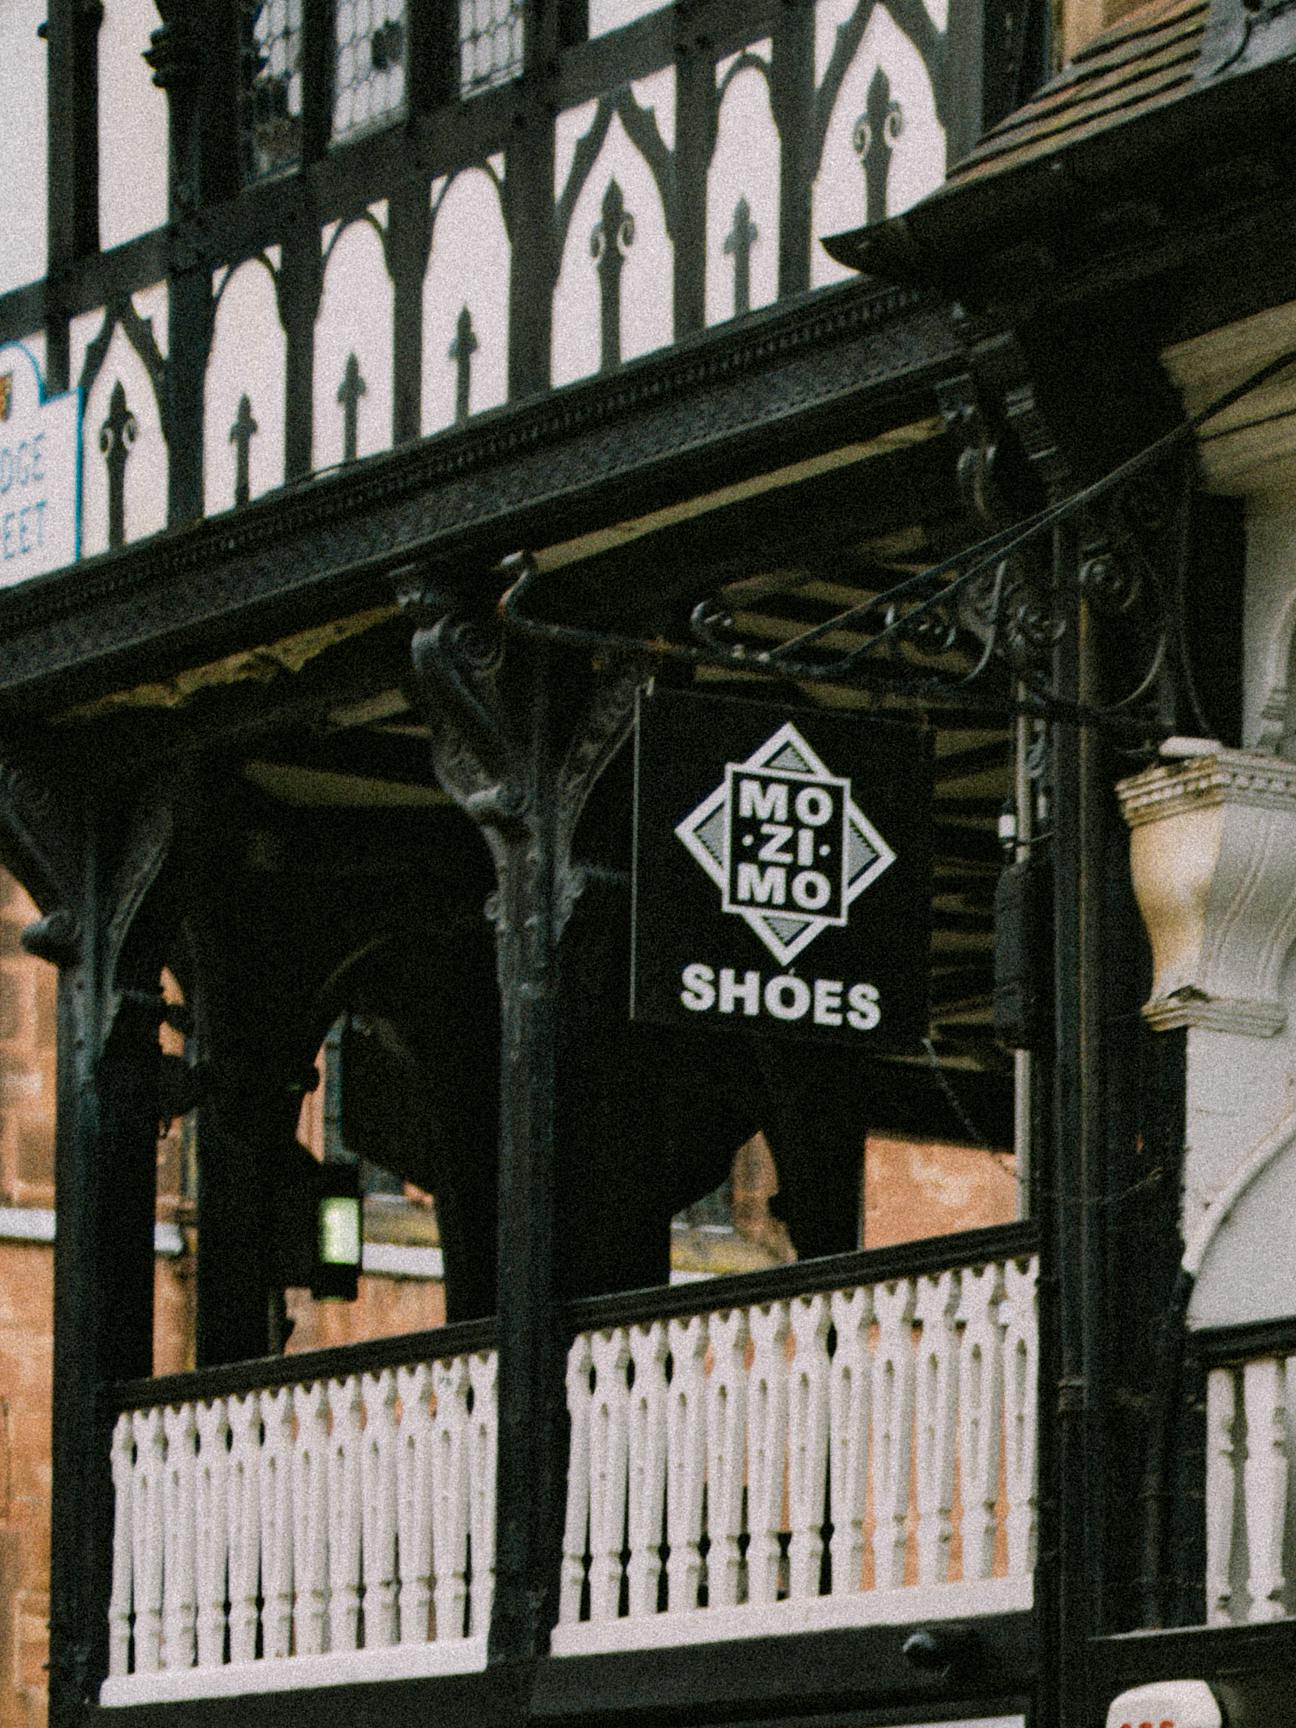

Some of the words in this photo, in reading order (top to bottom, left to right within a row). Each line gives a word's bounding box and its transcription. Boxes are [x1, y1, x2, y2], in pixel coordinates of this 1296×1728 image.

[738, 779, 834, 827] MO
[737, 862, 832, 911] MO
[680, 963, 882, 1031] SHOES
